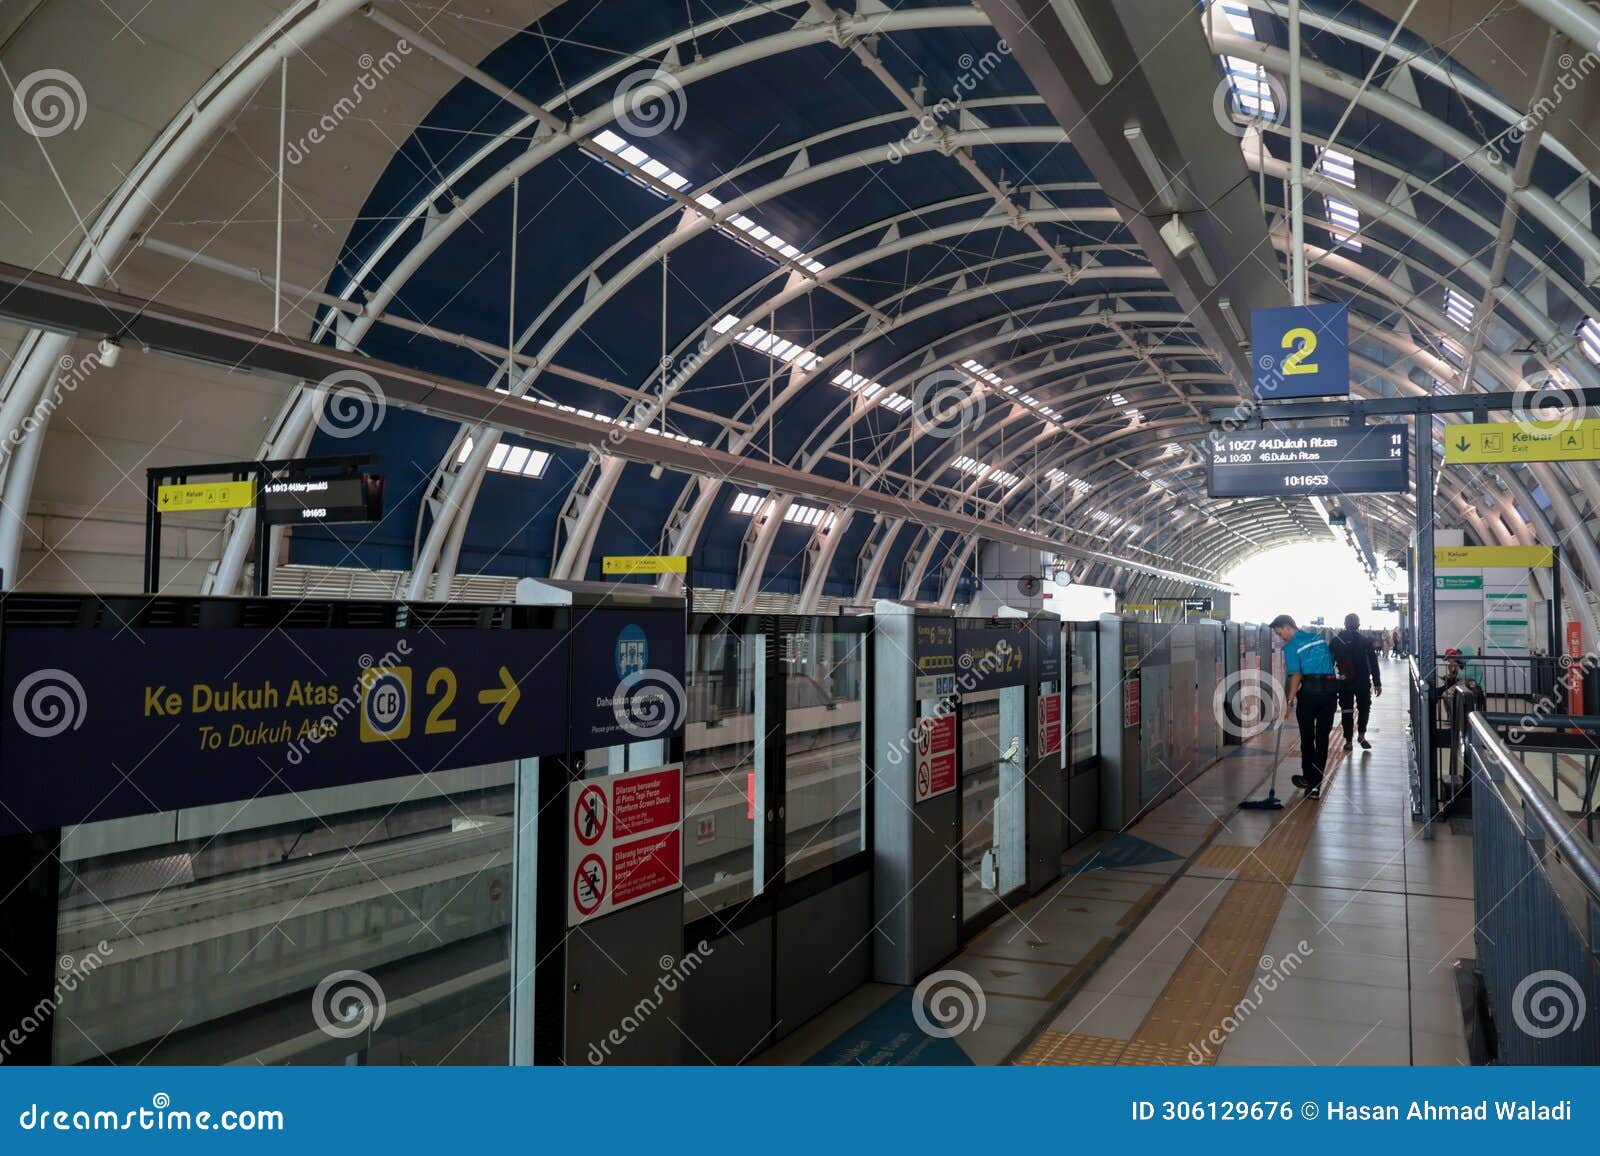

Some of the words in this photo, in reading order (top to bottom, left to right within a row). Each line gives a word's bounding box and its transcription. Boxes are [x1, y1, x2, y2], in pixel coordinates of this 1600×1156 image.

[1281, 328, 1319, 376] 2
[1310, 437, 1338, 448] Atas
[1391, 434, 1402, 445] 11
[1512, 432, 1552, 442] Keluar
[1567, 436, 1577, 446] A
[1298, 452, 1320, 461] Atas
[1390, 448, 1401, 457] 14
[144, 686, 182, 717] Ke
[192, 681, 278, 714] Dukuh
[286, 680, 339, 707] Atas
[424, 666, 458, 735] 2
[198, 726, 222, 751] To
[229, 719, 292, 748] Dukuh
